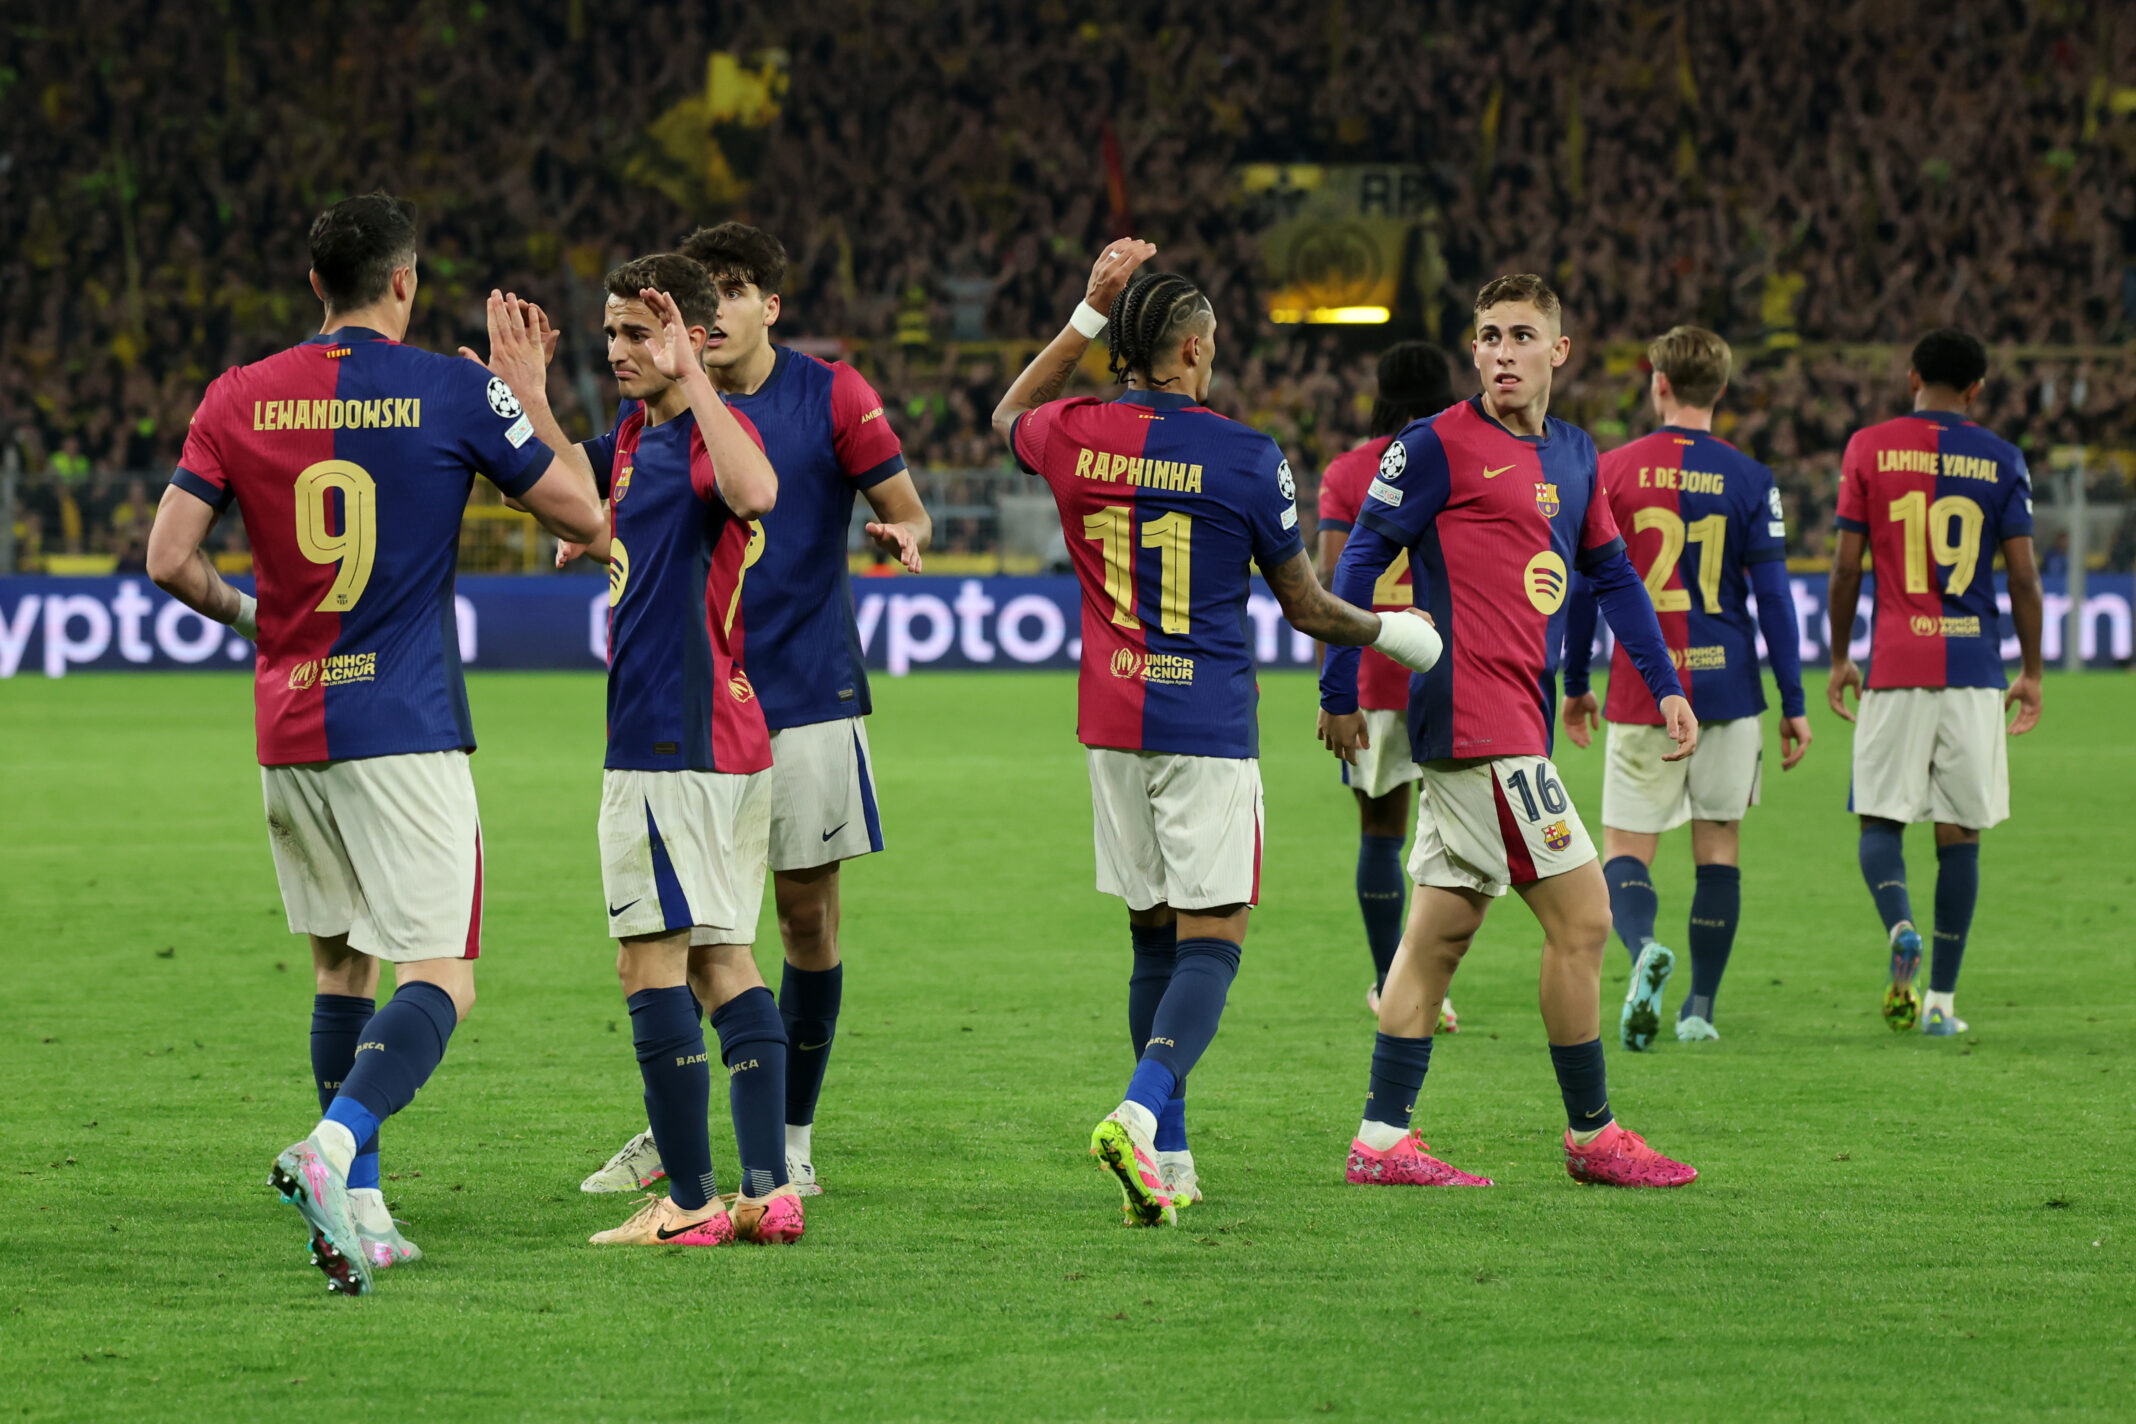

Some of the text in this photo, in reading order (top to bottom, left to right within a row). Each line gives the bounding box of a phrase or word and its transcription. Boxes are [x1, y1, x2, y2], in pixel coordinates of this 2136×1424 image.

[253, 398, 420, 431] LEWANDOWSKI
[1075, 448, 1203, 493] RAPHINHA
[1639, 467, 1724, 495] F. DE JONG
[1877, 450, 1999, 483] LAMINE YAMAL
[295, 459, 376, 612] 9
[1889, 490, 1985, 597] 19
[1083, 505, 1192, 634] 11
[1633, 506, 1728, 614] 21
[320, 663, 375, 681] ACNUR
[321, 652, 376, 668] UNHCR
[1140, 666, 1193, 680] ACNUR
[1144, 654, 1194, 668] UNHCR
[1507, 763, 1567, 822] 16
[729, 1059, 759, 1077] ARÇA
